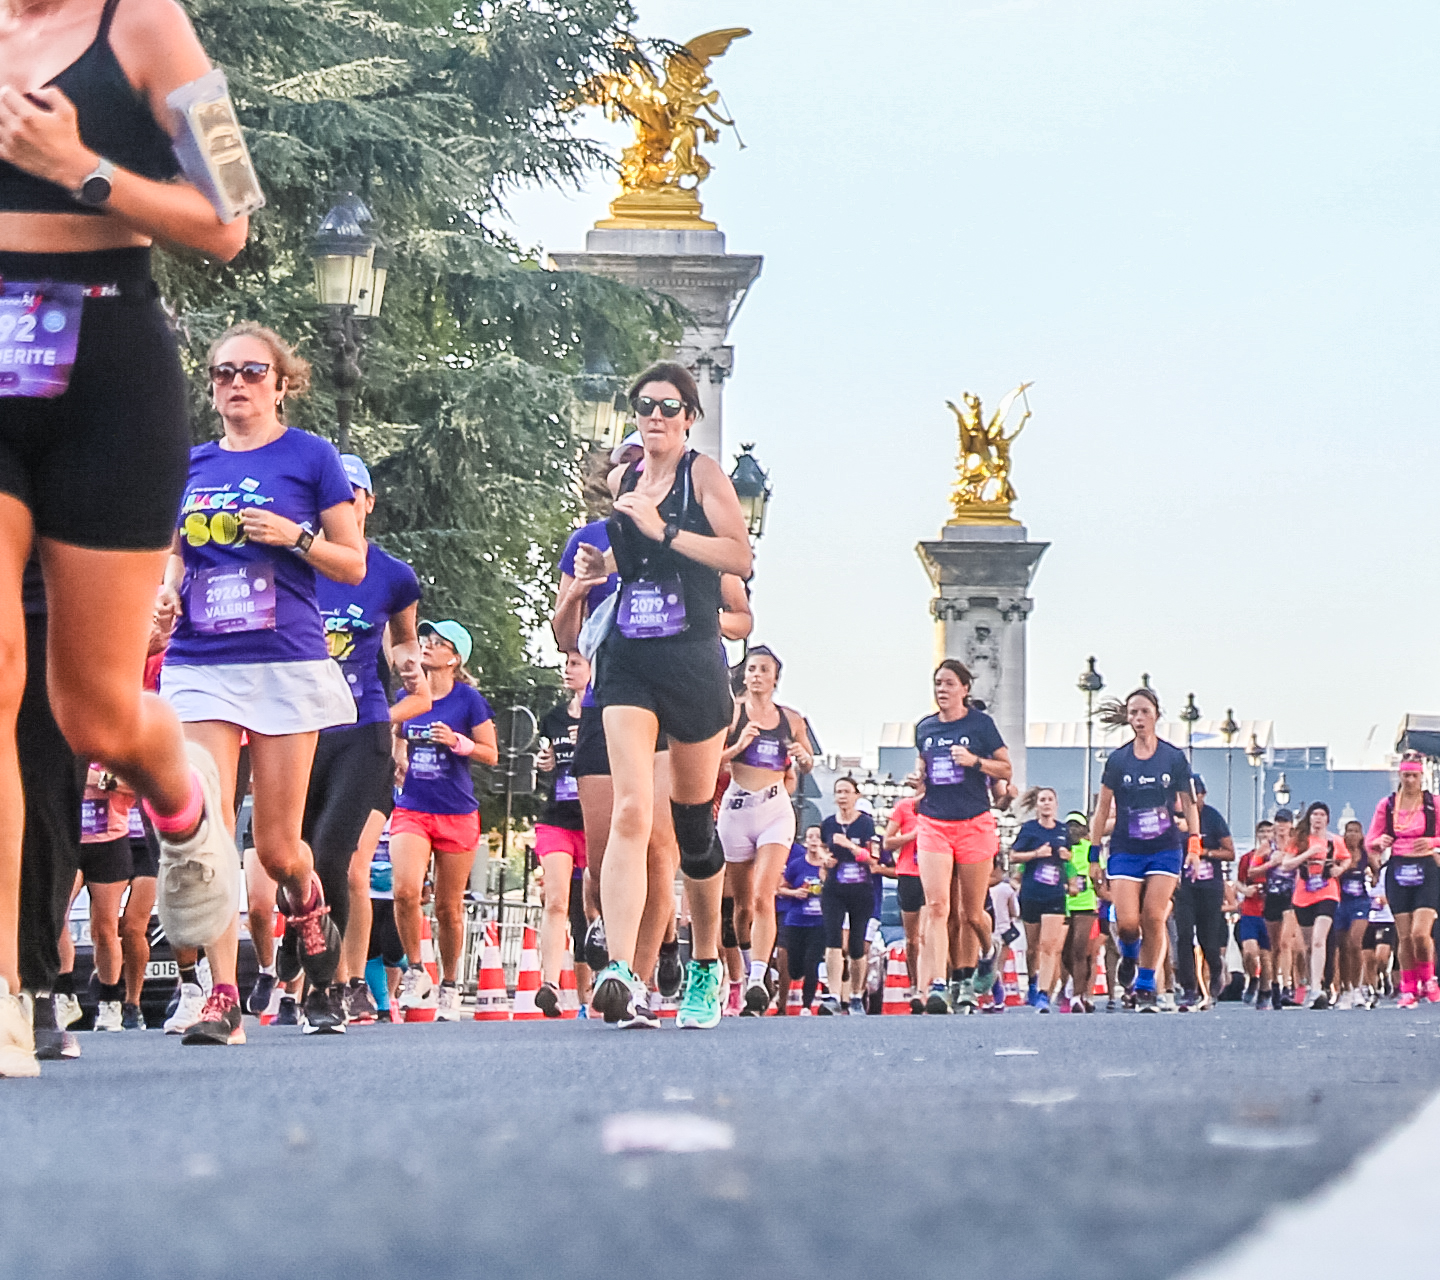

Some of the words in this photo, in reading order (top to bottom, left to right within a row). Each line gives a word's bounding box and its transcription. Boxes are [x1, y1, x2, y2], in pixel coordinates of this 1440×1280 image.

[205, 584, 251, 603] 29268
[204, 600, 255, 618] VALERIE
[630, 597, 664, 613] 2079
[629, 612, 669, 624] AUDREY
